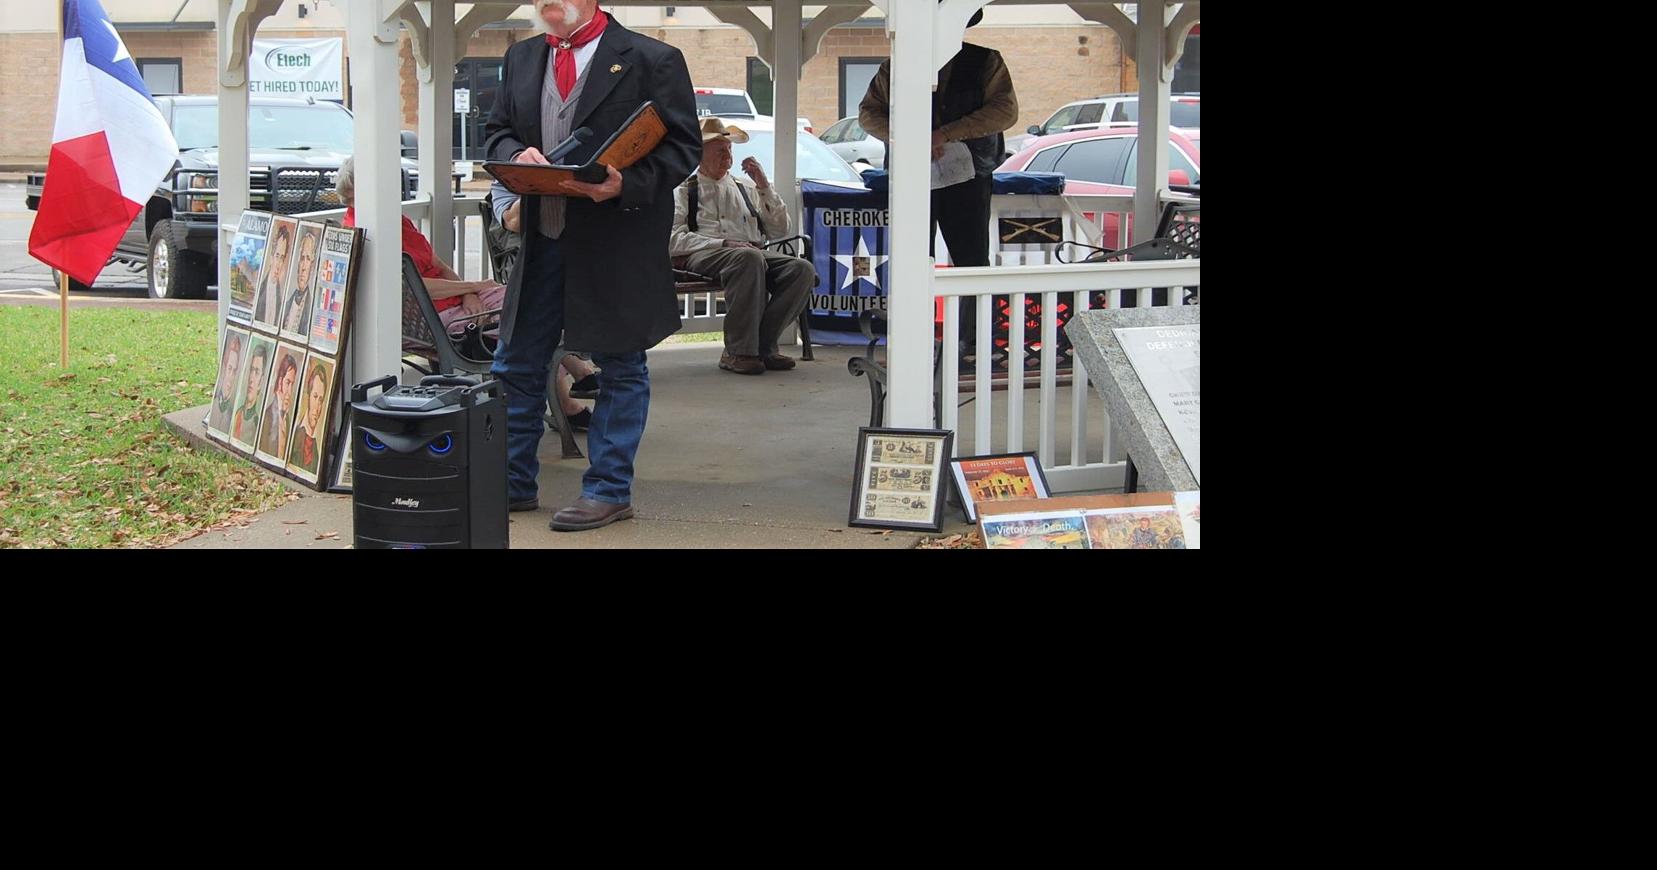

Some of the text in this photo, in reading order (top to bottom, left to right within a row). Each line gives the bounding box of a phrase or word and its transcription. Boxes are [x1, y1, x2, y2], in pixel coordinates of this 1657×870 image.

[276, 53, 311, 67] Etech
[264, 81, 296, 92] HIRED
[299, 81, 339, 93] TODAY!
